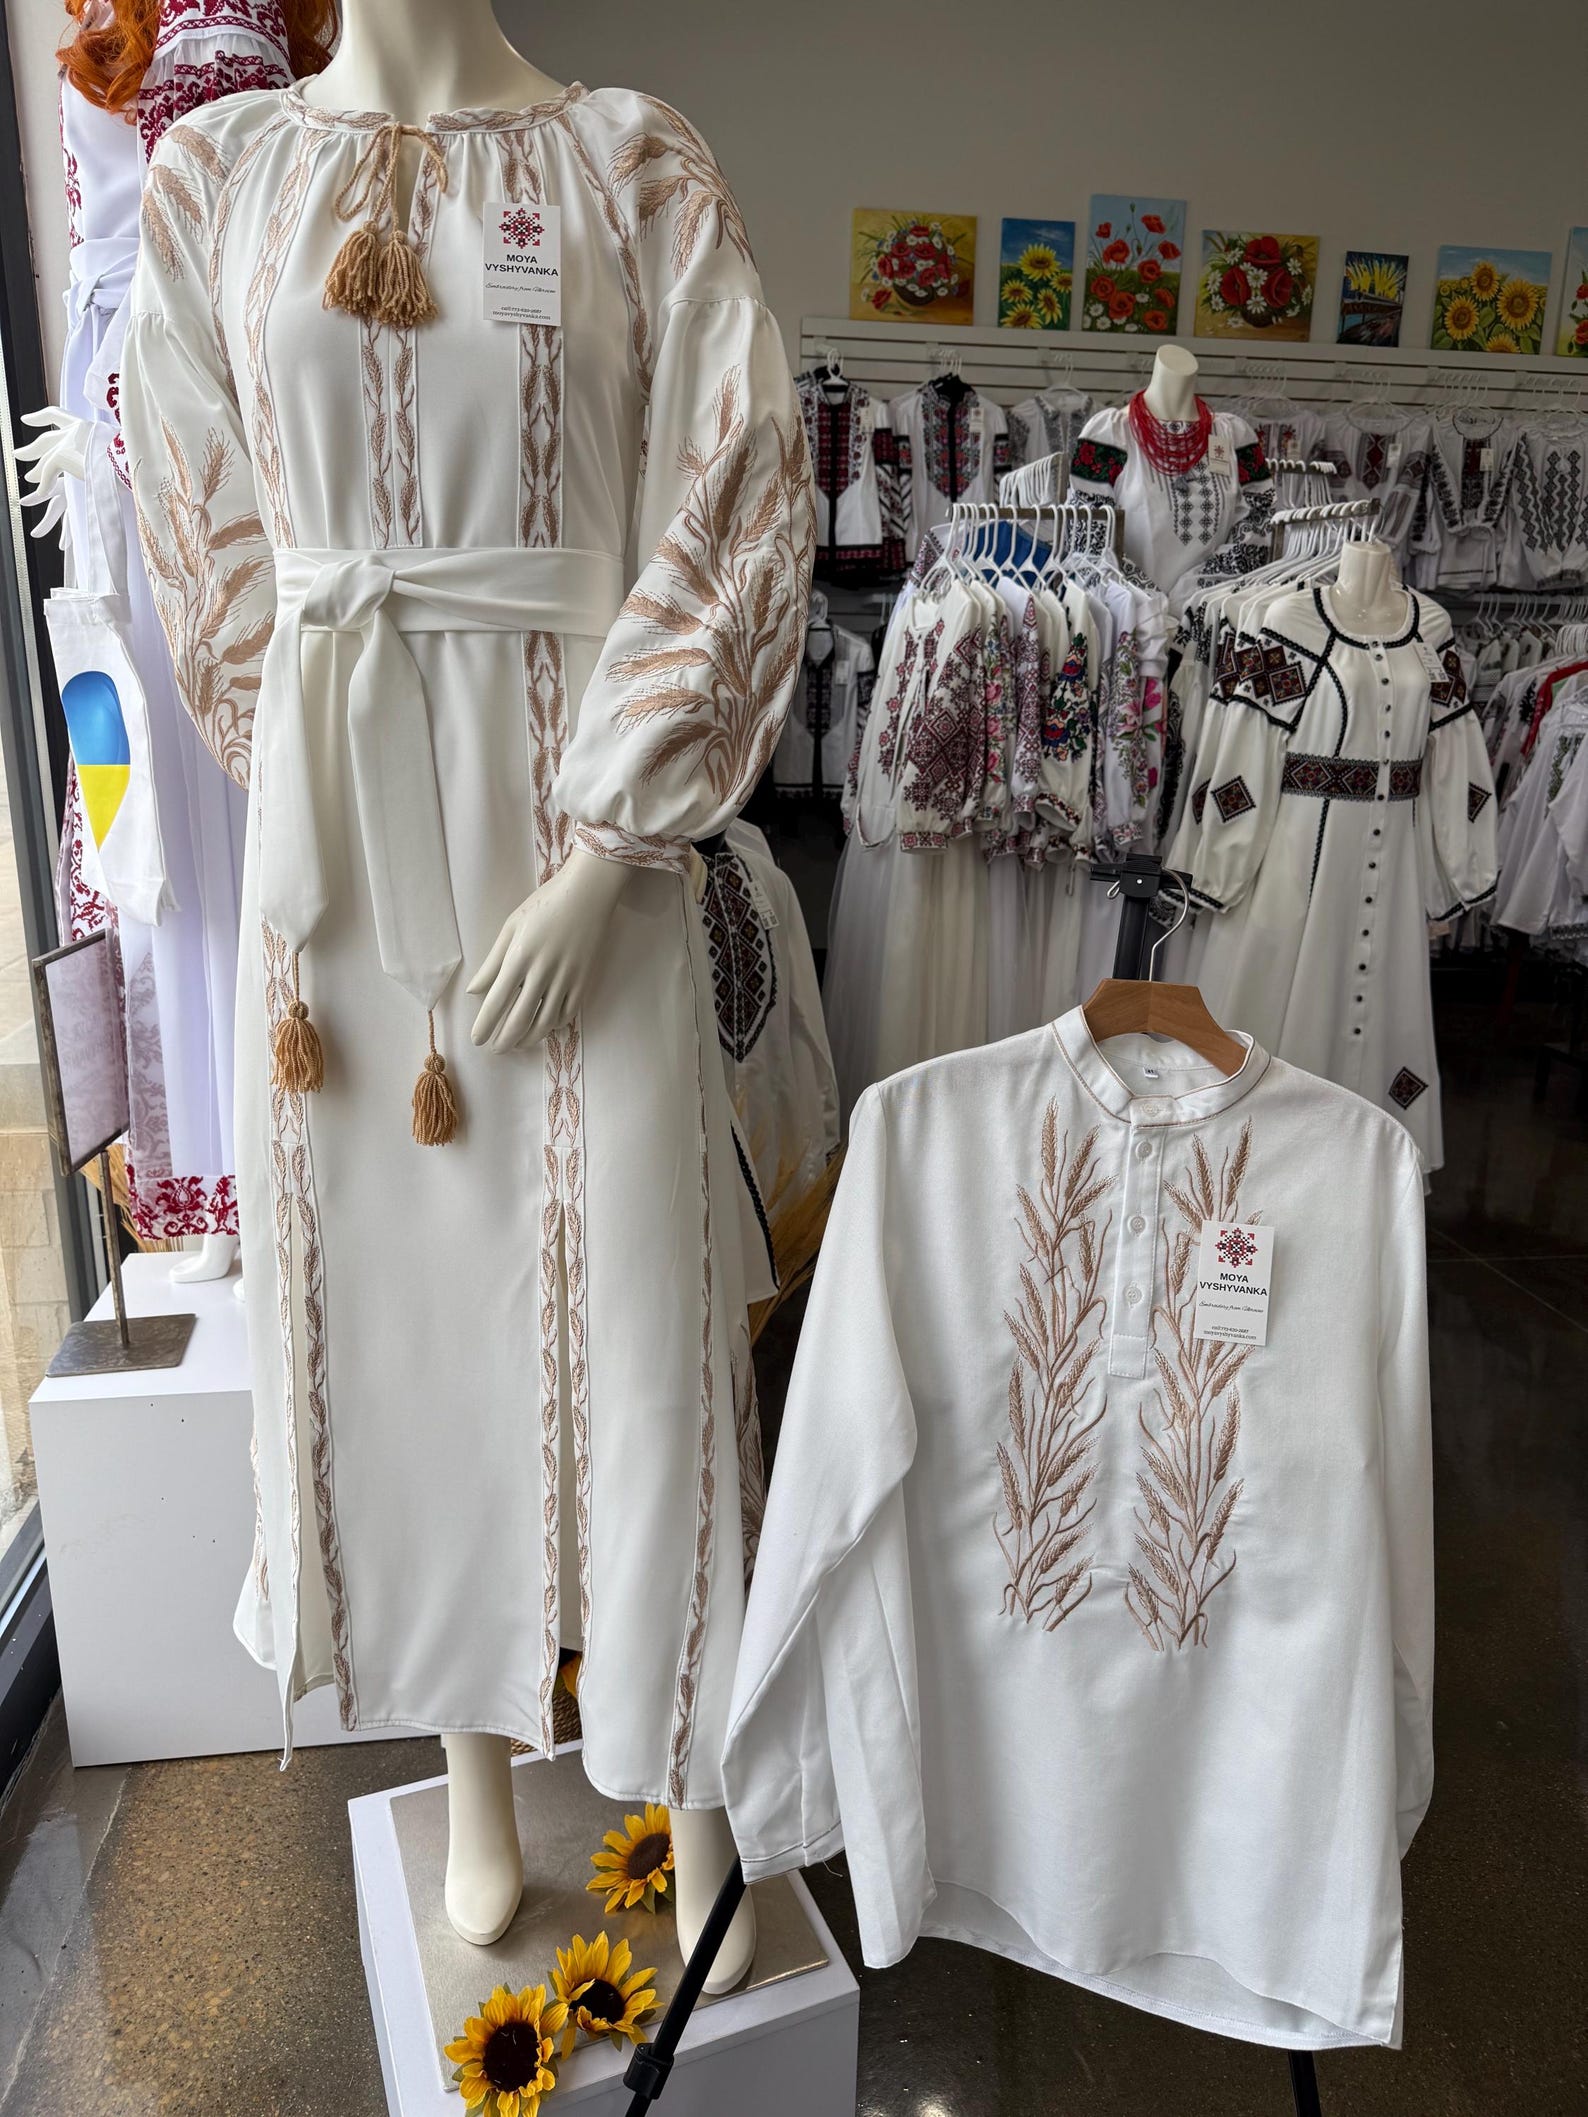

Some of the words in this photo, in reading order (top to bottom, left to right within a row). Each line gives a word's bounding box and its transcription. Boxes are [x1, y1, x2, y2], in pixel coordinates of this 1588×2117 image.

[506, 254, 538, 264] MOYA
[485, 263, 559, 277] VYSHYVANKA
[1219, 1272, 1249, 1283] MOYA
[1199, 1281, 1268, 1296] VYSHYVANKA
